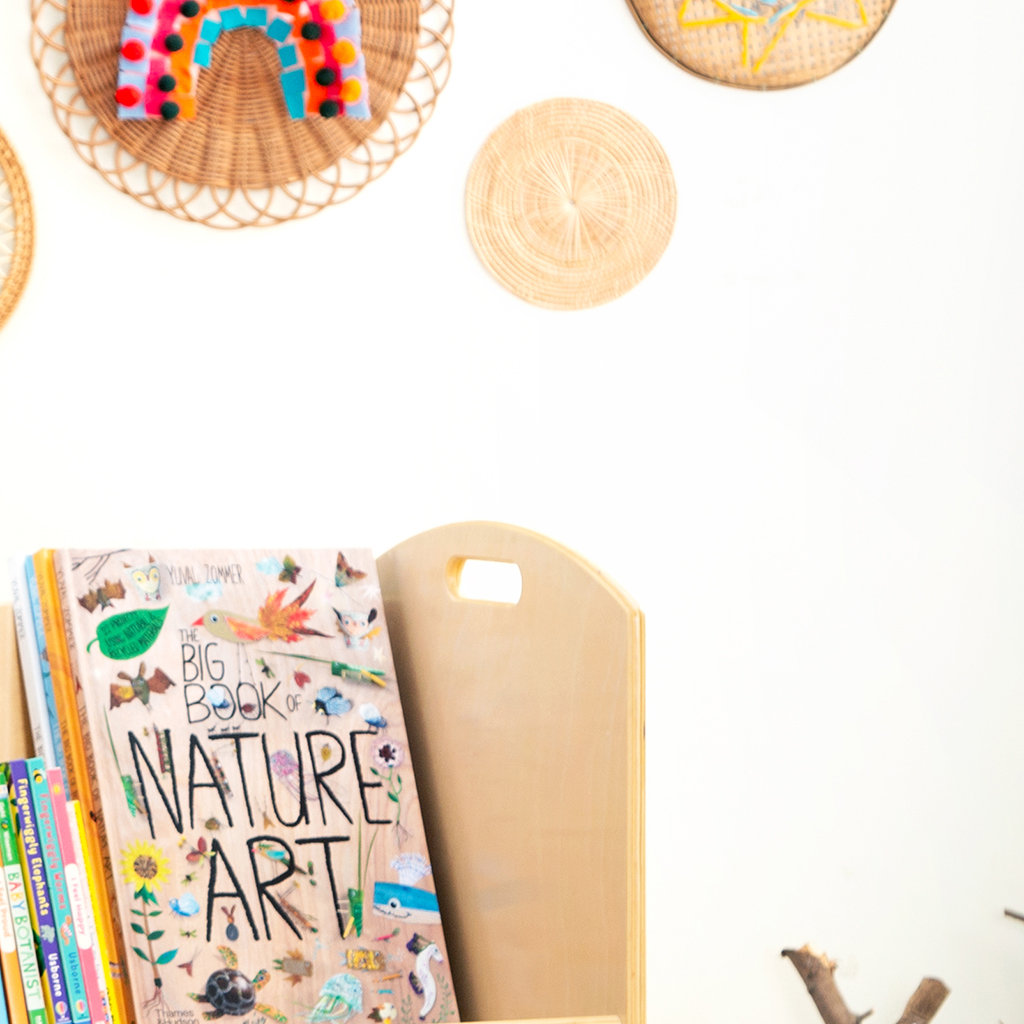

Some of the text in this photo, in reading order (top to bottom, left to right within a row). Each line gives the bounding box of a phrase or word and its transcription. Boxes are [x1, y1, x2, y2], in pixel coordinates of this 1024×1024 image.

[167, 563, 245, 586] YUVAL ZOMMER
[178, 628, 199, 642] THE
[181, 642, 225, 683] BIG
[183, 681, 303, 724] BOOK OF
[127, 729, 392, 840] NATURE
[17, 778, 50, 916] Fingerwiggly Elephants
[39, 793, 66, 909] Fingerwiggly Worms
[206, 835, 350, 942] ART
[8, 872, 40, 1001] BABY BOTANIST
[48, 953, 63, 997] Usborne
[68, 951, 82, 995] Usborne
[155, 1008, 195, 1018] Thames
